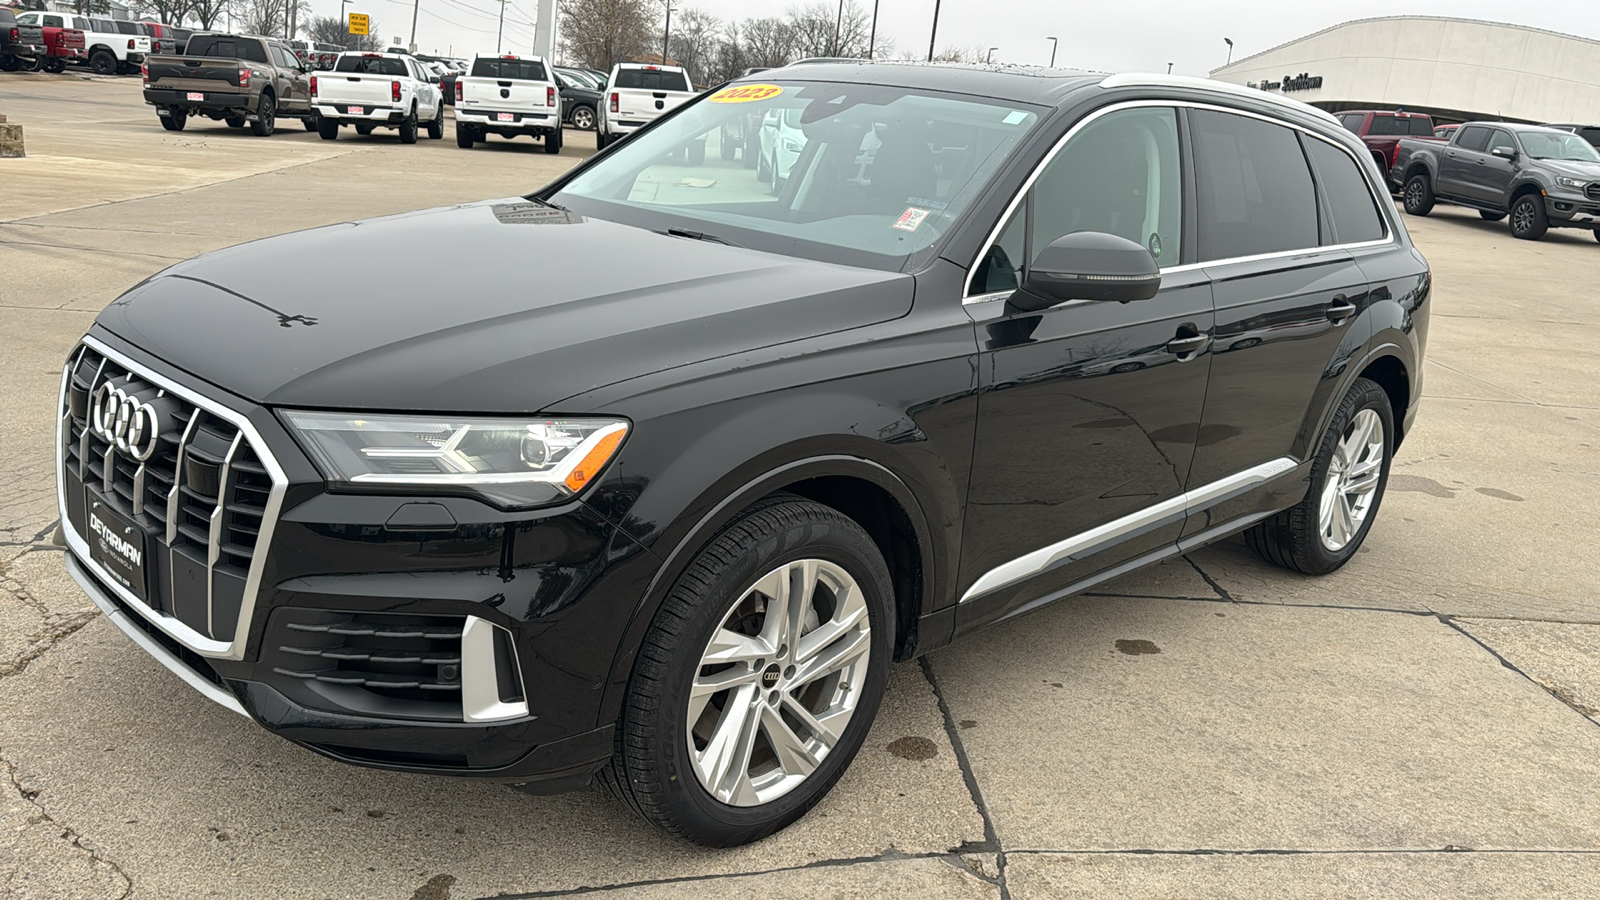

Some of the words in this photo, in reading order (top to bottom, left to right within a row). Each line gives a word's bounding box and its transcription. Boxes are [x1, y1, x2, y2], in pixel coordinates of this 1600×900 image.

[1282, 73, 1322, 92] Southtown
[713, 87, 778, 99] 2023
[90, 512, 141, 566] DEYARMAN
